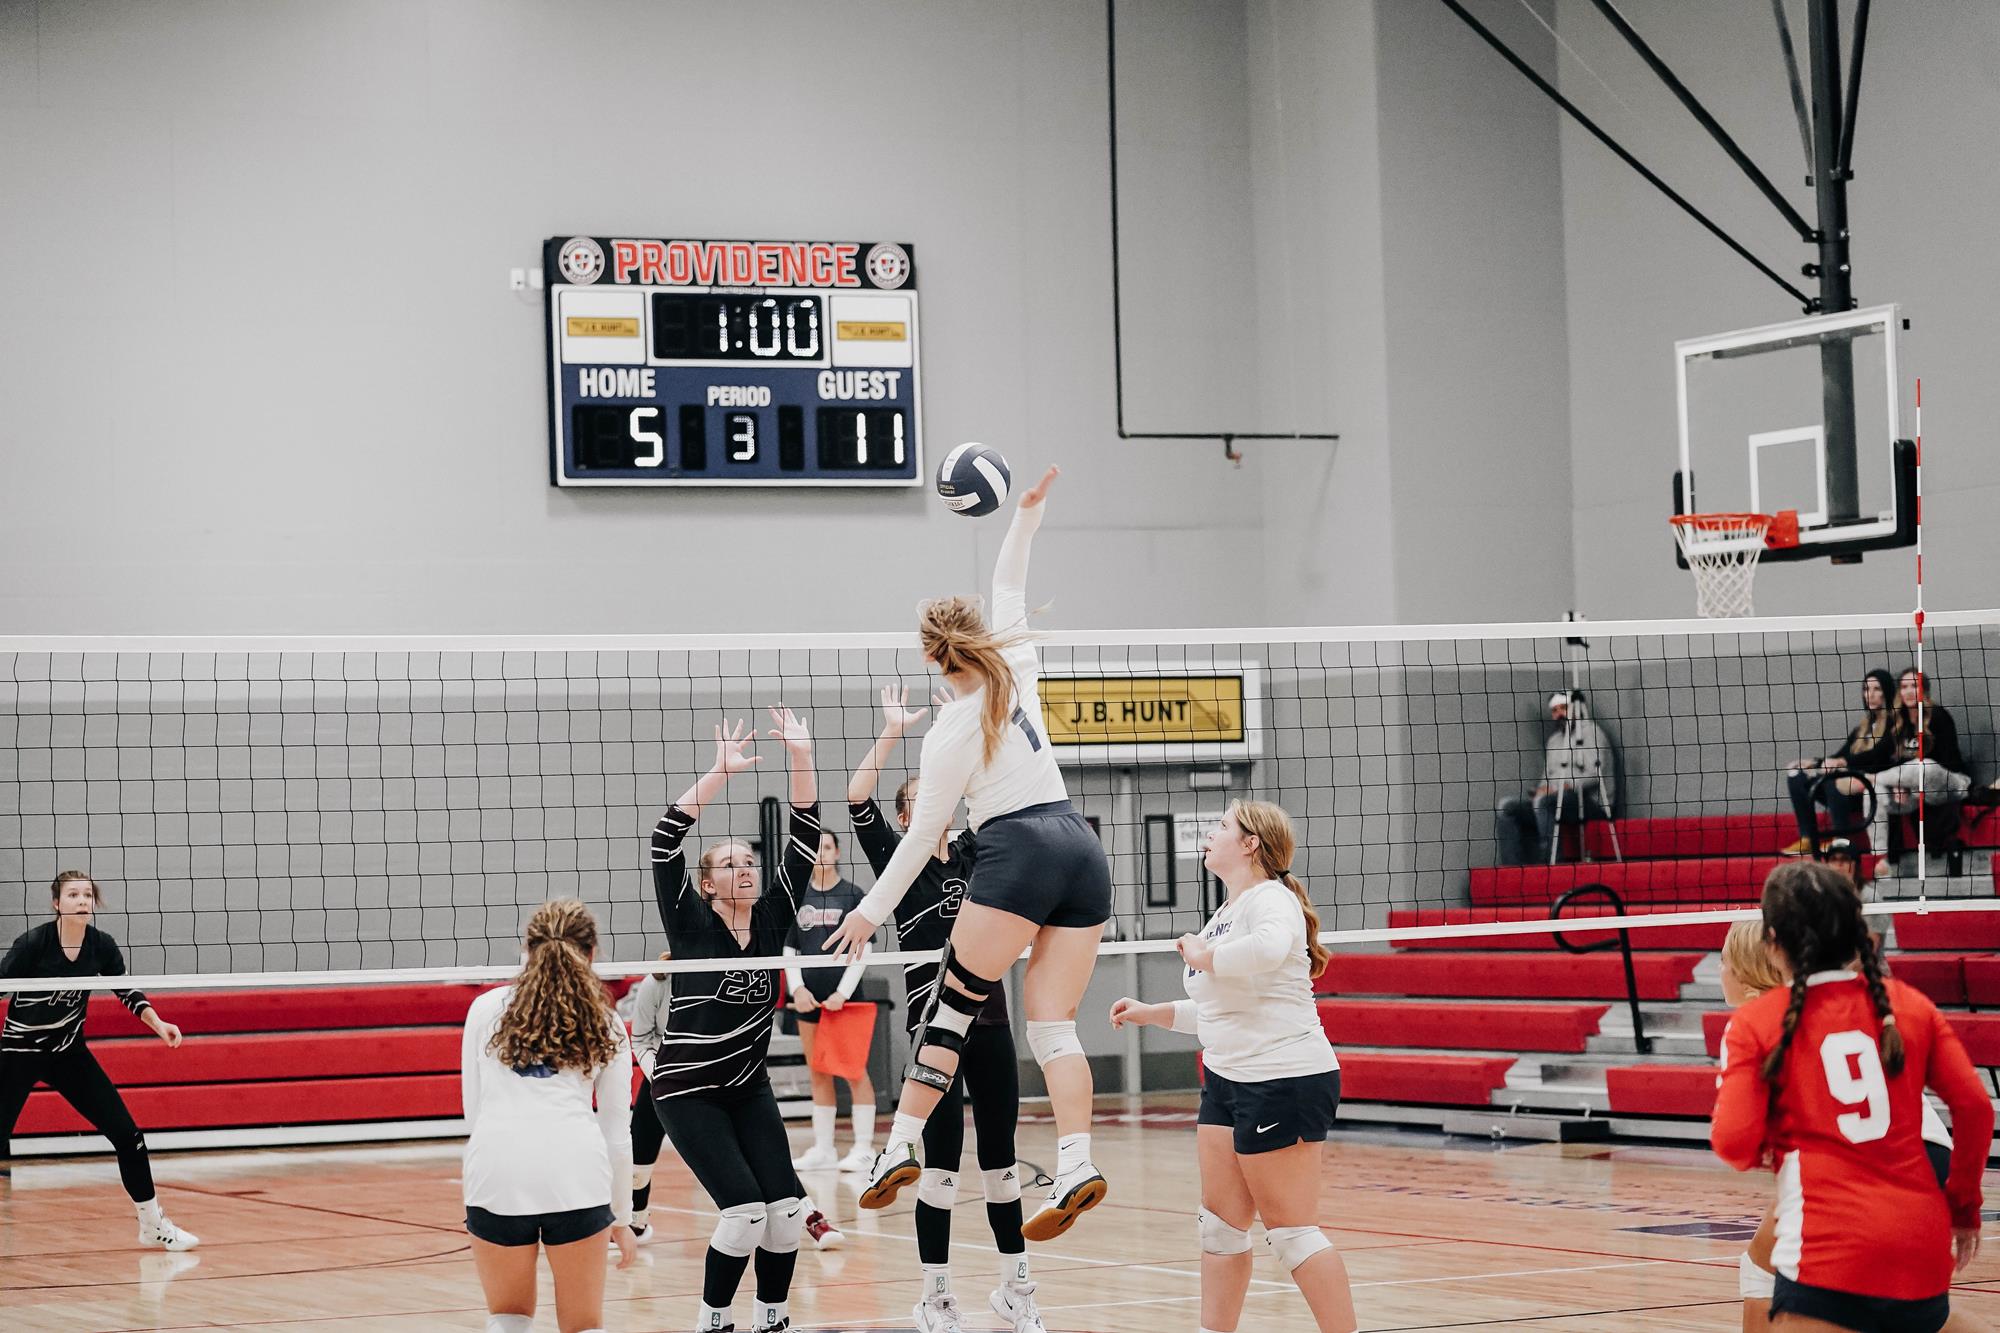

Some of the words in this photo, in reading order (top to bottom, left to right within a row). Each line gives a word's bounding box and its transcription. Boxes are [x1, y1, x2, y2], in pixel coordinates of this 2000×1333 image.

[611, 240, 861, 287] PROVIDENCE
[718, 299, 818, 357] 1:00
[579, 368, 657, 398] HOME
[707, 386, 771, 407] PERIOD
[817, 370, 901, 400] GUEST
[630, 407, 664, 467] 5
[733, 416, 755, 460] 3
[856, 412, 904, 464] 11
[1122, 700, 1188, 722] HUNT
[714, 968, 772, 1004] 23
[1820, 1029, 1891, 1144] 9
